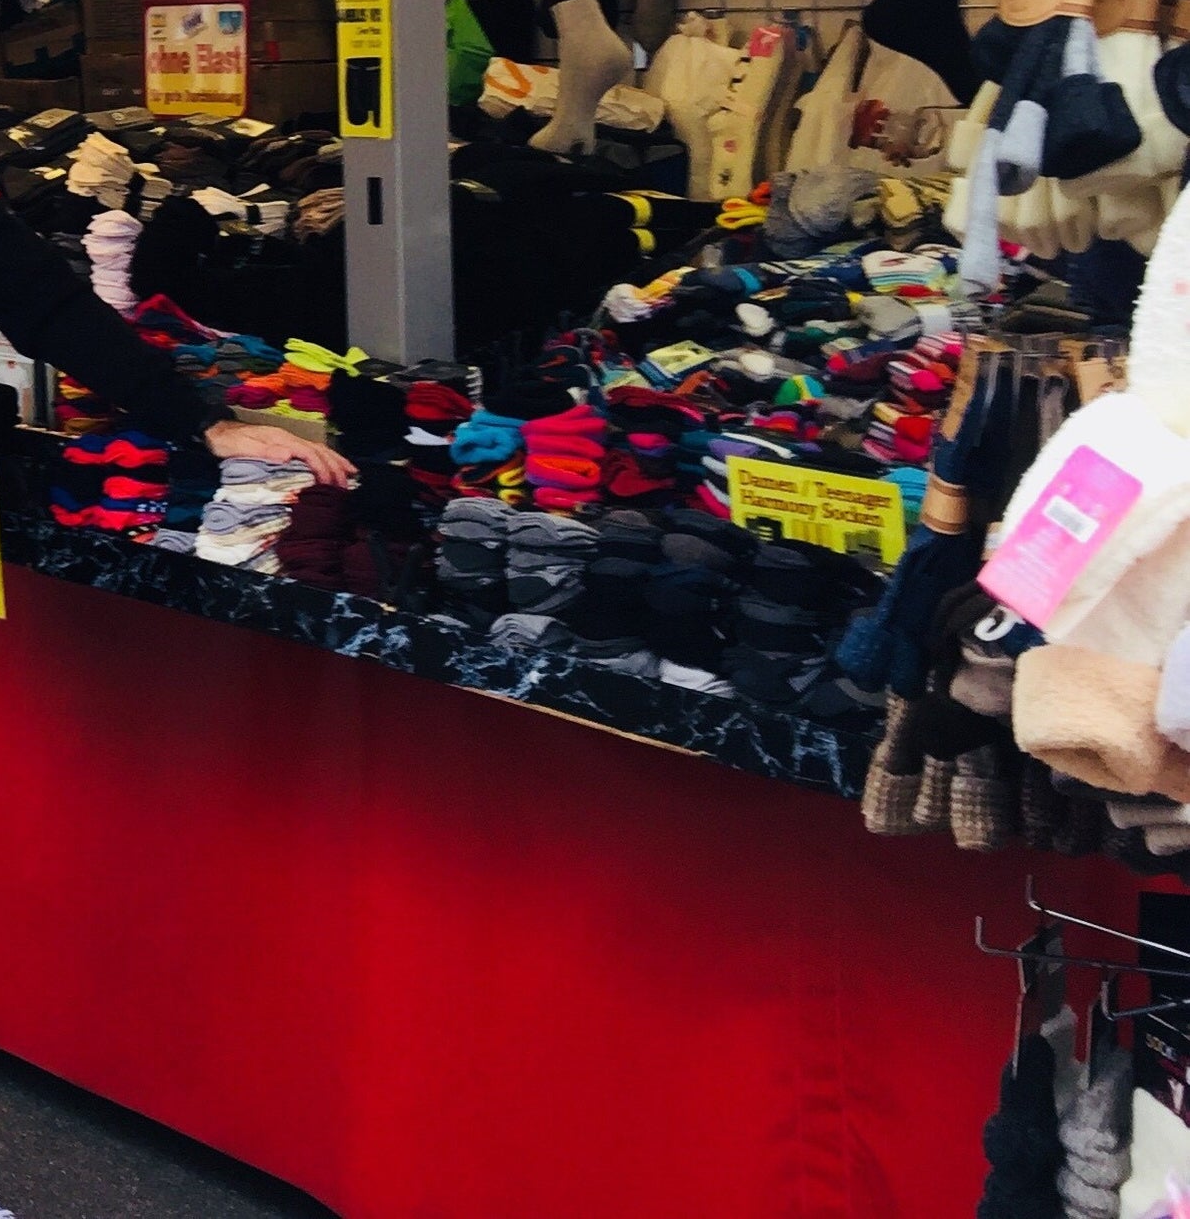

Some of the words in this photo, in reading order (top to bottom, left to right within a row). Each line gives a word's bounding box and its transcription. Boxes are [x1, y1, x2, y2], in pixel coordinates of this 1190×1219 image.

[738, 469, 798, 494] Damen
[814, 481, 891, 510] Teenager
[822, 502, 885, 528] Socken
